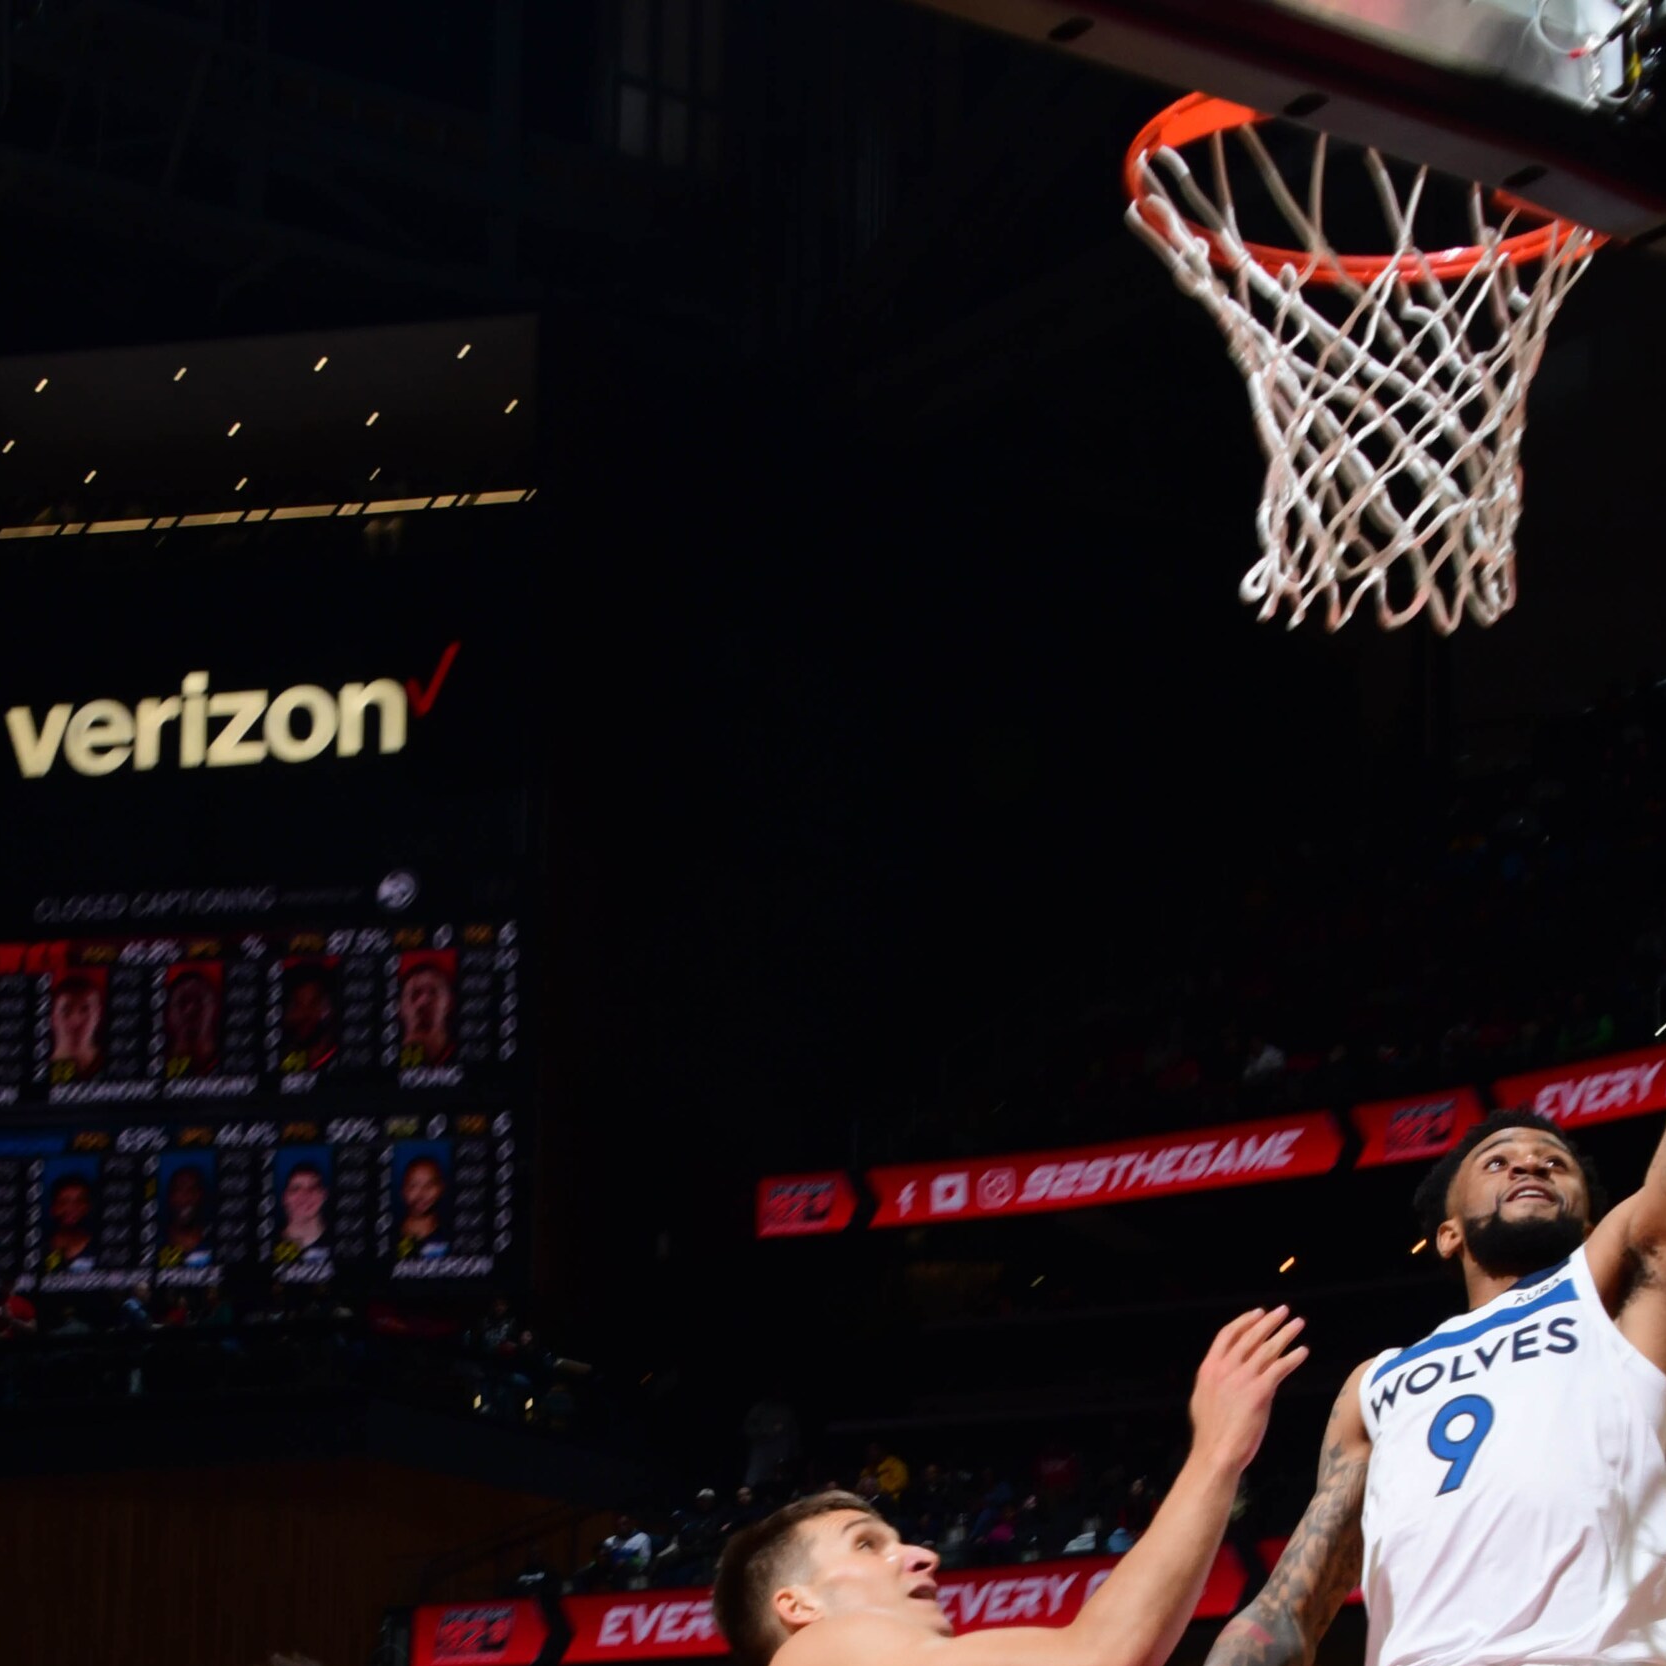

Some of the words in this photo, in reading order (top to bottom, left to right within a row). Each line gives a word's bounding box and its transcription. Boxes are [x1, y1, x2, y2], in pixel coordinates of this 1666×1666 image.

[4, 669, 409, 779] verizon
[1017, 1127, 1306, 1204] 929THEGAME
[1370, 1317, 1580, 1423] WOLVES
[1428, 1394, 1494, 1497] 9
[596, 1599, 717, 1646] EVER
